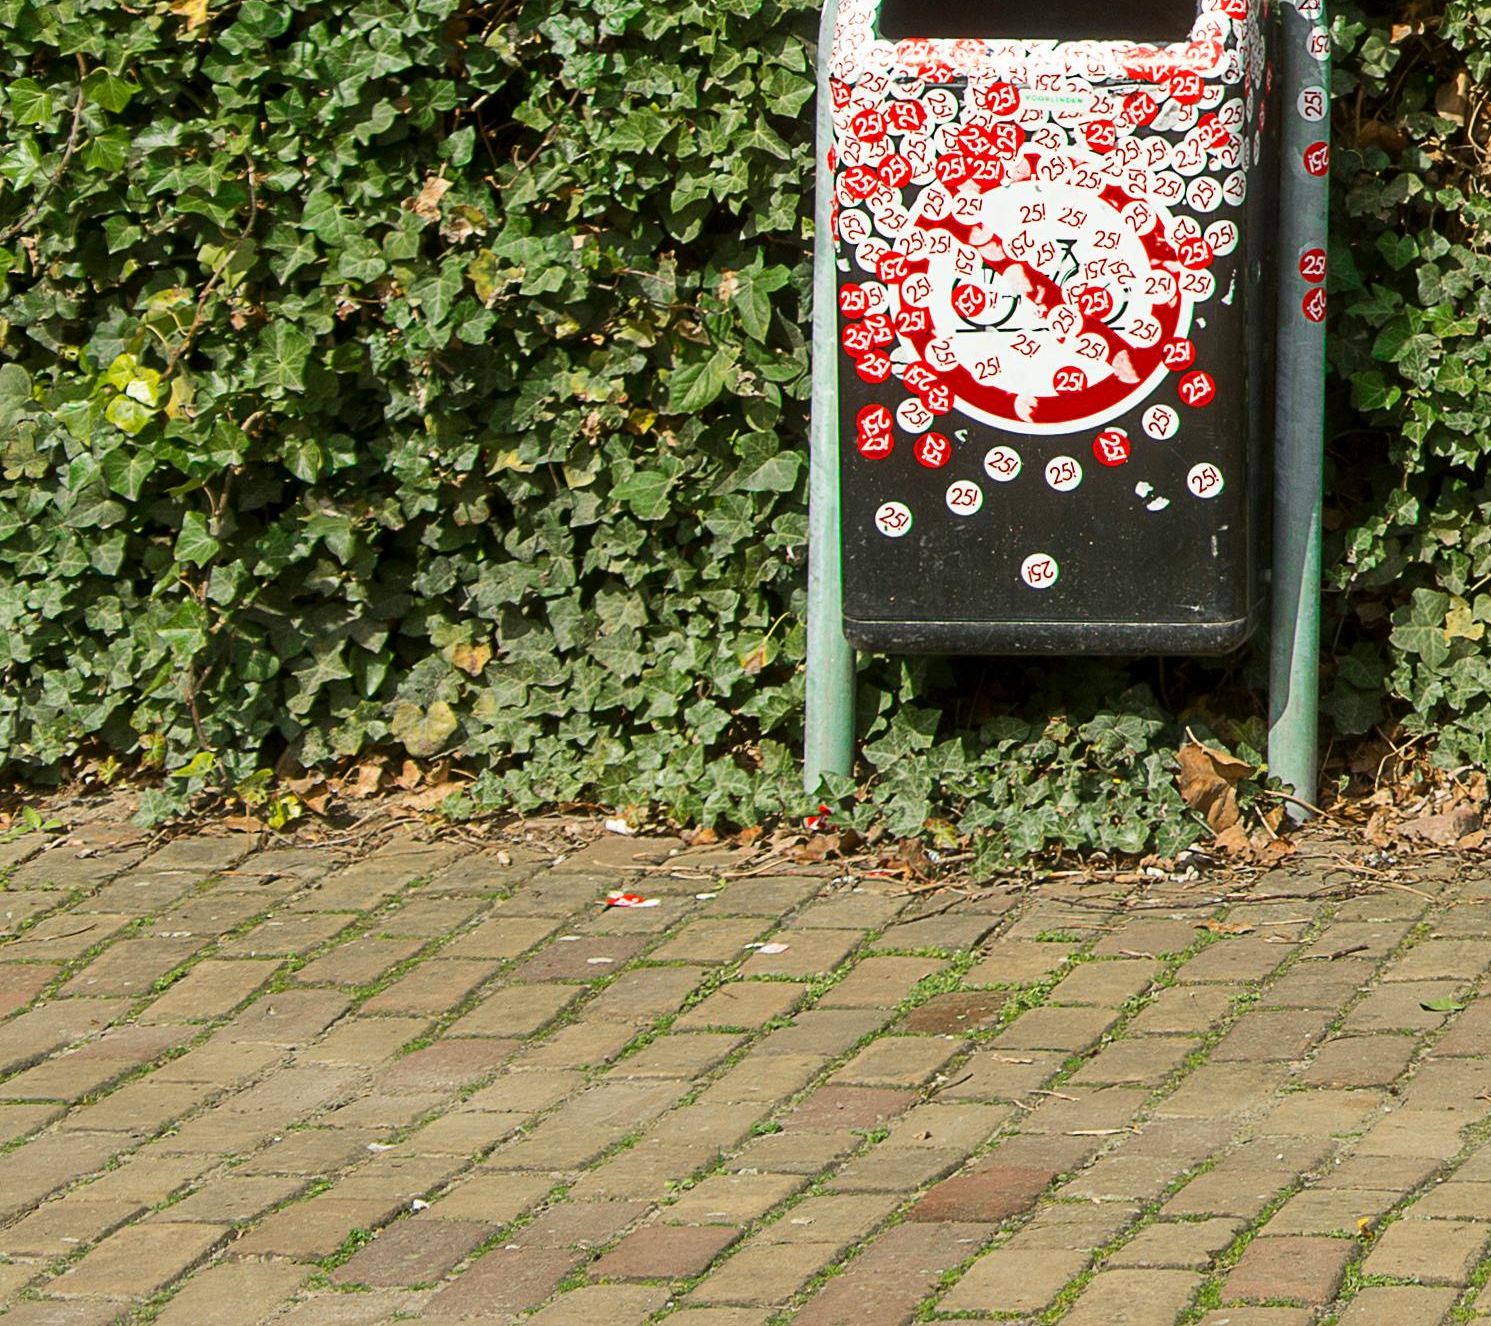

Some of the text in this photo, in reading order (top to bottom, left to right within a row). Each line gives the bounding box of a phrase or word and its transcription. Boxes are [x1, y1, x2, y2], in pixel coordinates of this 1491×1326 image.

[859, 72, 888, 94] 25!
[1036, 74, 1061, 91] 25!
[1172, 75, 1199, 97] 25!
[928, 93, 952, 119] 25!
[987, 85, 1016, 111] 25!
[1089, 95, 1114, 114] 25!
[1127, 94, 1155, 125] 25!
[1305, 91, 1323, 117] 25!
[896, 102, 919, 126] 25!
[1178, 105, 1193, 121] 5!
[855, 114, 883, 137] 25!
[997, 123, 1016, 152] 25!
[1087, 124, 1115, 147] 25!
[844, 136, 860, 163] 25!
[959, 128, 990, 155] 25!
[1036, 128, 1061, 152] 25!
[1116, 139, 1142, 166] 25!
[1148, 140, 1168, 166] 25!
[881, 154, 908, 181] 25!
[938, 156, 966, 182] 25!
[973, 160, 999, 180] 25!
[1041, 156, 1068, 181] 25!
[1076, 170, 1102, 189] 25!
[846, 168, 877, 192] 25!
[1128, 169, 1147, 194] 25!
[1153, 177, 1182, 198] 25!
[923, 188, 946, 217] 25!
[1192, 179, 1216, 209] 25!
[956, 198, 983, 216] 25!
[1020, 203, 1046, 223] 25!
[1058, 207, 1088, 228] 25!
[1125, 204, 1152, 232] 25!
[842, 214, 866, 240] 25!
[878, 208, 908, 232] 25!
[900, 231, 927, 255] 25!
[929, 235, 950, 254] 25!
[1007, 230, 1035, 259] 25!
[1093, 231, 1121, 250] 25!
[1209, 224, 1235, 249] 25!
[956, 248, 976, 275] 25!
[1037, 241, 1056, 267] 25!
[1181, 241, 1209, 266] 25!
[1302, 255, 1325, 275] 25!
[881, 258, 908, 280] 25!
[1084, 258, 1107, 280] 25!
[1107, 259, 1136, 285] 25!
[906, 277, 933, 303] 25!
[1145, 276, 1172, 295] 25!
[1183, 274, 1211, 294] 25!
[841, 291, 864, 310] 25!
[955, 285, 983, 316] 25!
[1081, 292, 1109, 315] 25!
[864, 316, 893, 343] 25!
[898, 311, 925, 333] 25!
[1052, 306, 1077, 334] 25!
[1129, 319, 1159, 341] 25!
[844, 328, 872, 350] 25!
[1011, 334, 1041, 358] 25!
[1076, 339, 1106, 360] 25!
[931, 337, 956, 366] 25!
[1164, 342, 1190, 364] 25!
[858, 353, 890, 378] 25!
[975, 356, 1001, 380] 25!
[904, 365, 938, 391] 25!
[1056, 372, 1084, 391] 25!
[1183, 373, 1211, 404] 25!
[928, 385, 949, 411] 25!
[861, 408, 890, 439] 25!
[901, 402, 931, 428] 25!
[1149, 408, 1172, 437] 25!
[921, 435, 945, 466] 25!
[1099, 434, 1127, 461] 25!
[988, 452, 1019, 475] 25!
[1050, 461, 1077, 485] 25!
[1192, 466, 1219, 493] 25!
[951, 488, 978, 506] 25!
[879, 507, 909, 531] 25!
[1027, 560, 1054, 583] 25!
